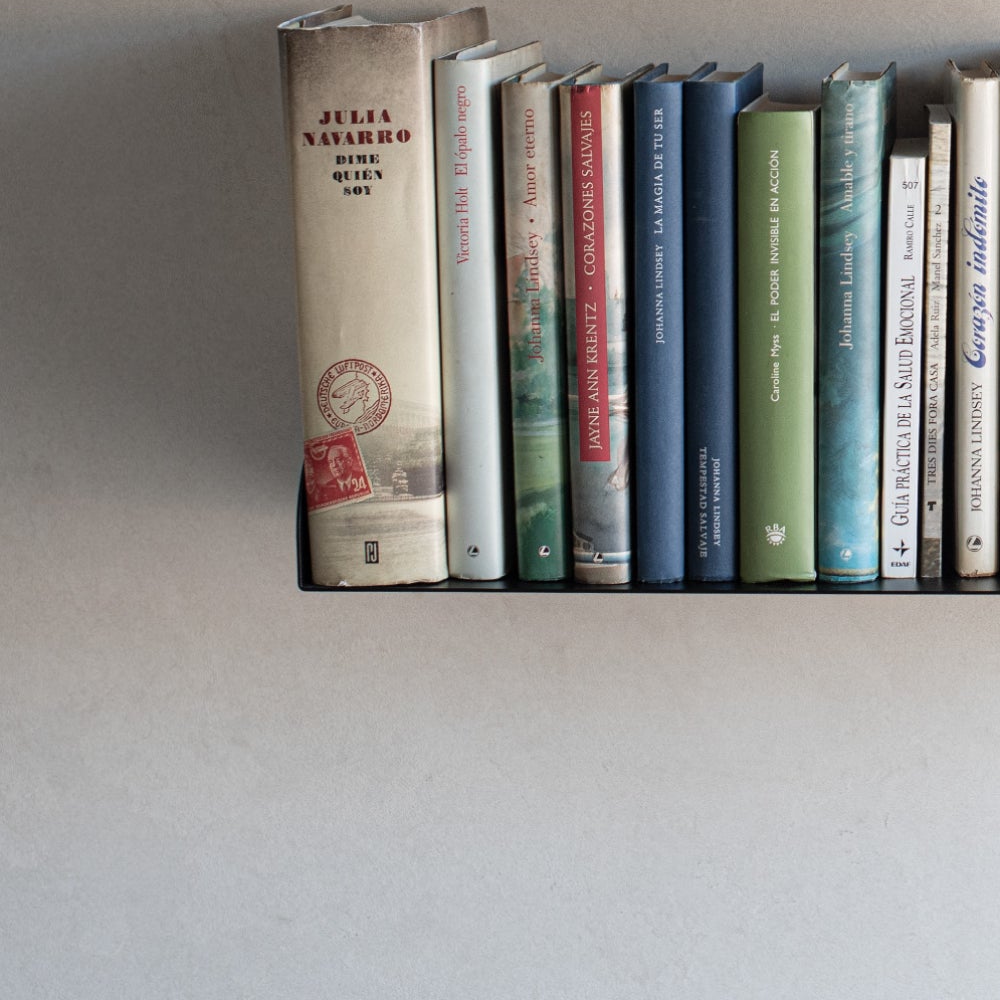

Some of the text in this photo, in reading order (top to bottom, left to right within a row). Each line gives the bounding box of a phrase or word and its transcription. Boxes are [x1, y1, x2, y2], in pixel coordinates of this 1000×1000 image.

[302, 129, 411, 146] NAVARRO
[318, 109, 392, 125] JULIA
[332, 168, 383, 183] QUIÉN
[336, 154, 380, 165] DIME
[343, 185, 372, 196] SOY
[454, 85, 472, 264] Victoria Holt El ópalo negro
[902, 181, 918, 190] 507
[654, 108, 665, 344] JOHANNA LINDSEY LA MAGIA DE TU SER
[838, 103, 858, 350] Johanna Lindsey Amable y tirano
[580, 111, 603, 450] JAYNE ANN KRENTZ CORAZONES SALVAJES
[768, 150, 782, 402] Caroline Myss EL PODER INVISIBLE EN ACCIÓN
[961, 176, 994, 512] JOHANNA LINDSEY Corazón indómito
[320, 361, 374, 414] DEUTSCHE LUFTPOST
[351, 476, 368, 493] 24
[697, 446, 707, 558] TEMPESTAD SALVAJE
[712, 457, 721, 546] JOHANNA LINDSEY
